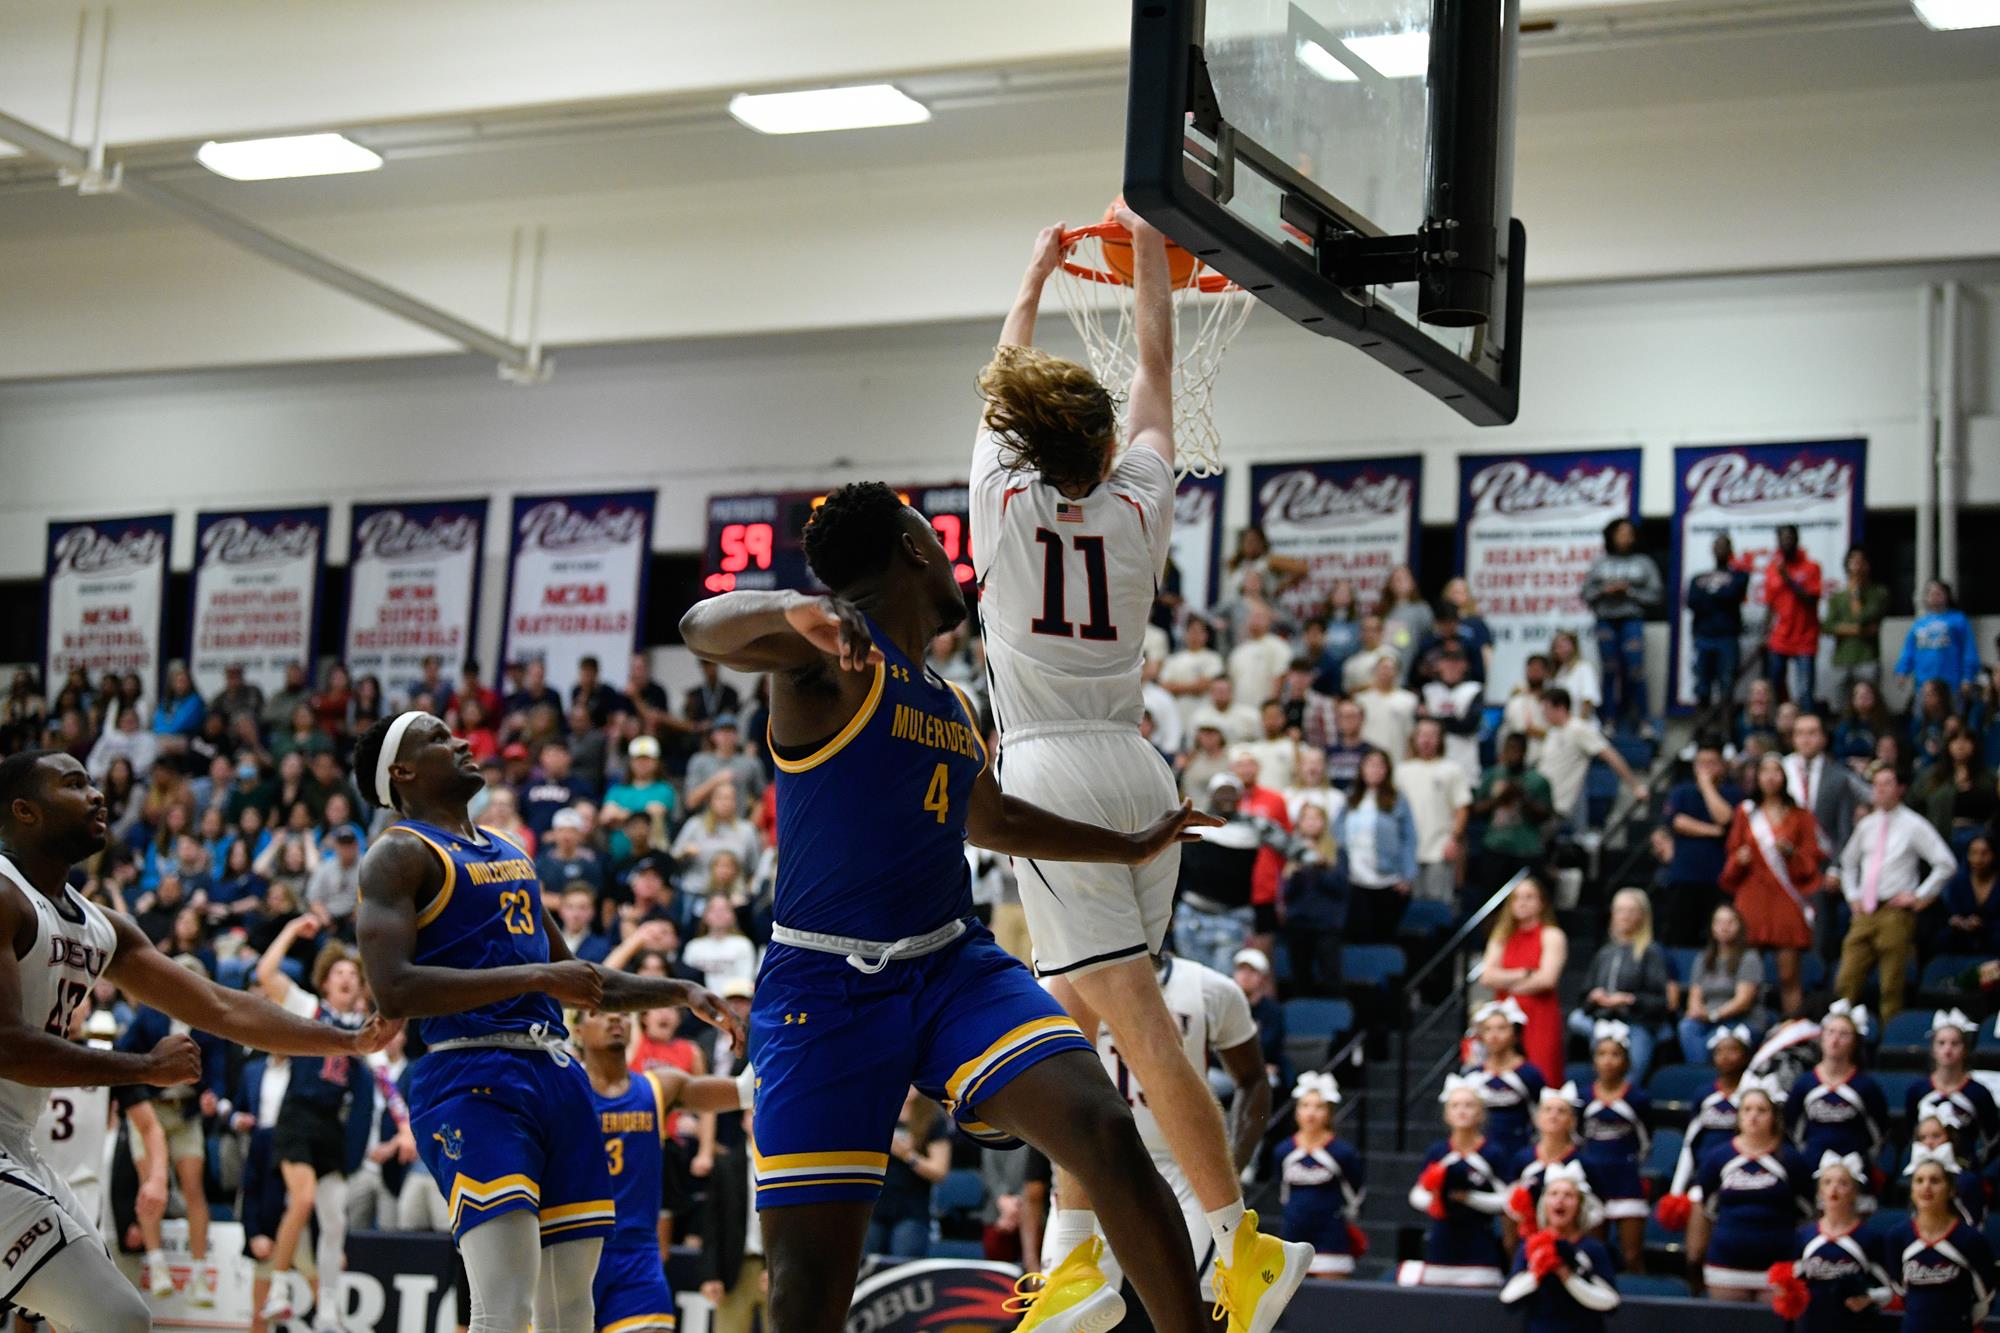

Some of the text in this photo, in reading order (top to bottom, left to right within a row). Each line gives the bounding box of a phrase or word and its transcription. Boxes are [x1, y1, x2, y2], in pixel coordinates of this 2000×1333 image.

[720, 523, 773, 573] 59
[1031, 527, 1118, 641] 11
[923, 762, 949, 824] 4
[500, 889, 534, 935] 23
[48, 934, 107, 979] DBU
[51, 1098, 74, 1141] 3
[600, 1111, 654, 1133] ERIDERS
[605, 1138, 624, 1176] 3
[2, 1217, 53, 1271] DBU
